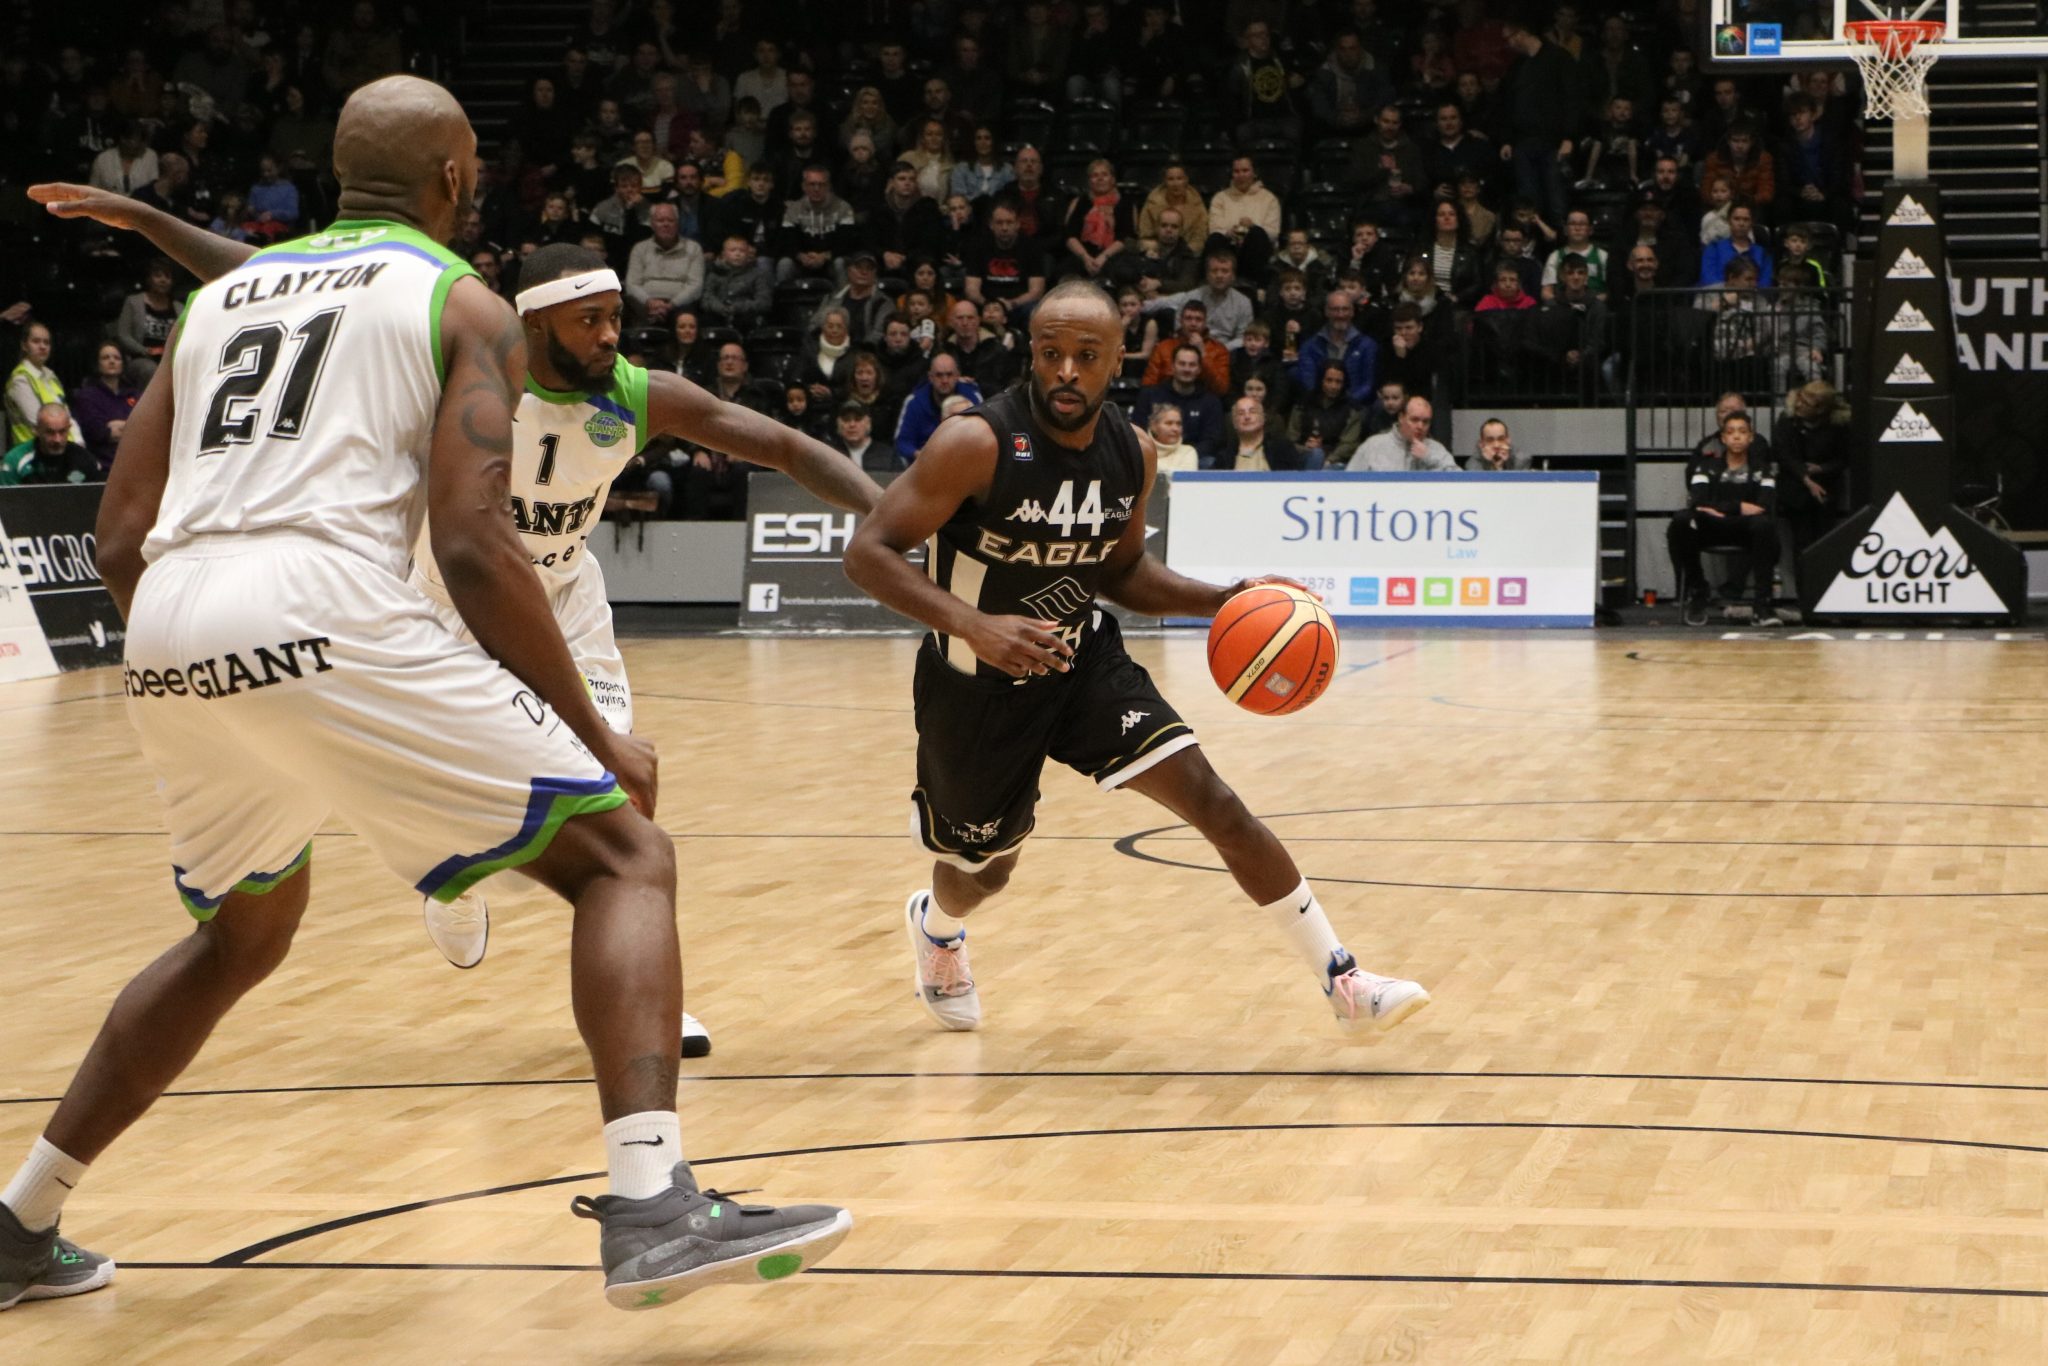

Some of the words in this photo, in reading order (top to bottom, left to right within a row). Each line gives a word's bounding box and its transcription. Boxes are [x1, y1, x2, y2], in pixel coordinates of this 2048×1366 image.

[222, 262, 389, 311] CLAYTON
[195, 305, 347, 458] 21
[535, 433, 561, 486] 1
[1047, 479, 1105, 537] 44
[1281, 496, 1480, 542] Sintons
[753, 512, 856, 553] ESH
[1446, 546, 1479, 560] Law
[1844, 531, 1978, 580] Coors
[1867, 582, 1951, 604] LIGHT
[594, 693, 627, 708] uying
